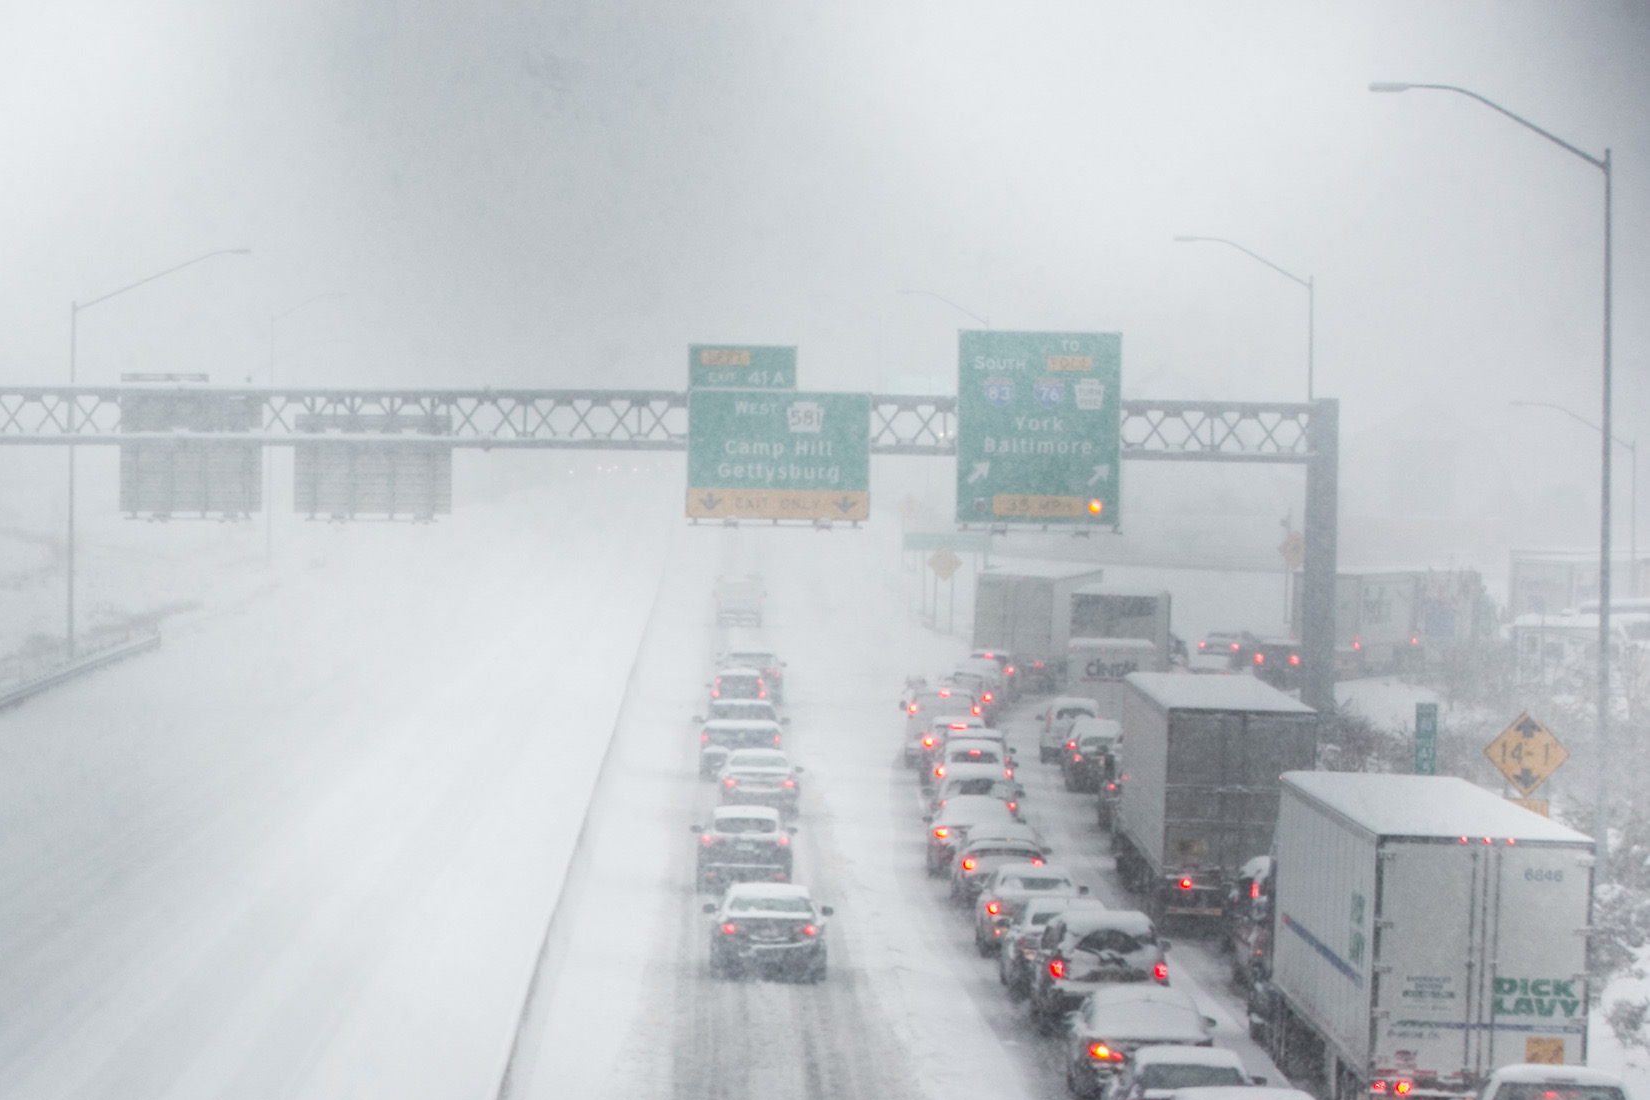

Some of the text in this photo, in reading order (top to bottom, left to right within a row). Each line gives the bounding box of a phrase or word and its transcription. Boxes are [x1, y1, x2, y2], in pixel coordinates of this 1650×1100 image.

[1061, 340, 1080, 352] TO
[974, 356, 1026, 371] SOUTH
[708, 371, 736, 384] EXIT
[988, 386, 1011, 401] 83
[1039, 386, 1059, 401] 76
[735, 401, 778, 415] WEST
[790, 409, 821, 426] 581
[1014, 415, 1063, 431] York
[725, 440, 833, 460] Camp Hill
[984, 436, 1093, 455] Baltimore
[717, 462, 840, 483] Gettysburg
[735, 497, 821, 510] EXIT ONLY
[1007, 498, 1073, 513] 35 MPH
[1494, 977, 1575, 998] DICK
[1493, 997, 1581, 1017] LAVY
